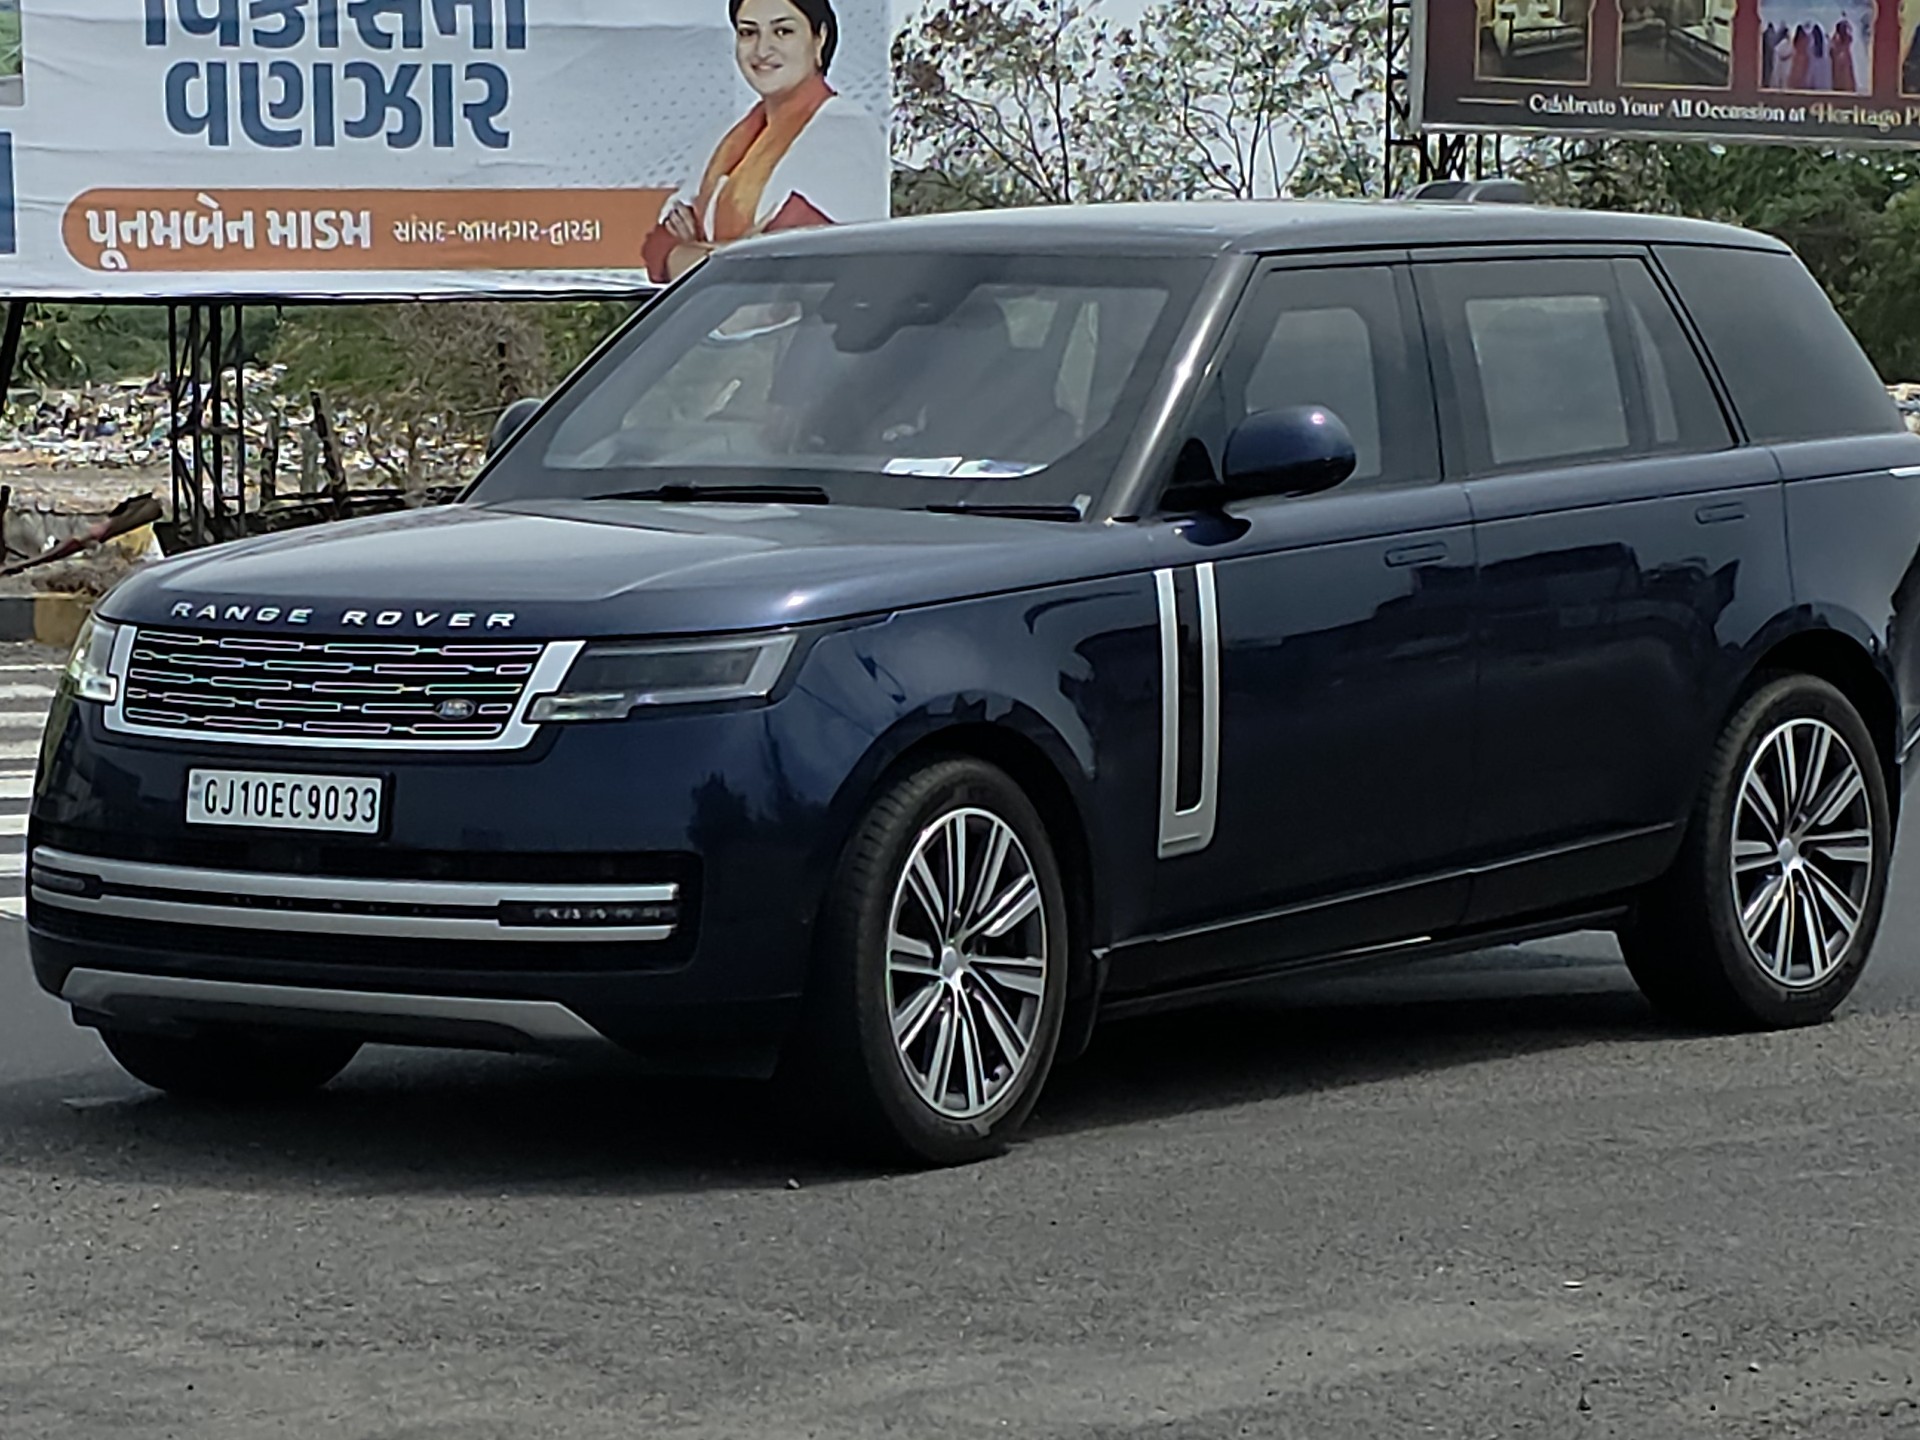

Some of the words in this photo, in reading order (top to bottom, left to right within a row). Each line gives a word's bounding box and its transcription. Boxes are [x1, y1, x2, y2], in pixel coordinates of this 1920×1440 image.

[164, 60, 511, 149] વણઝાર
[1529, 92, 1616, 115] Celebrate
[1619, 95, 1664, 116] Your
[1667, 98, 1693, 118] All
[1788, 105, 1806, 123] at
[1810, 101, 1901, 133] Heritage
[85, 191, 256, 270] પૂનમબેન
[265, 209, 372, 250] માડમ
[170, 601, 313, 624] RANGE
[341, 609, 516, 630] ROVER
[204, 778, 377, 823] GJ10EC9033
